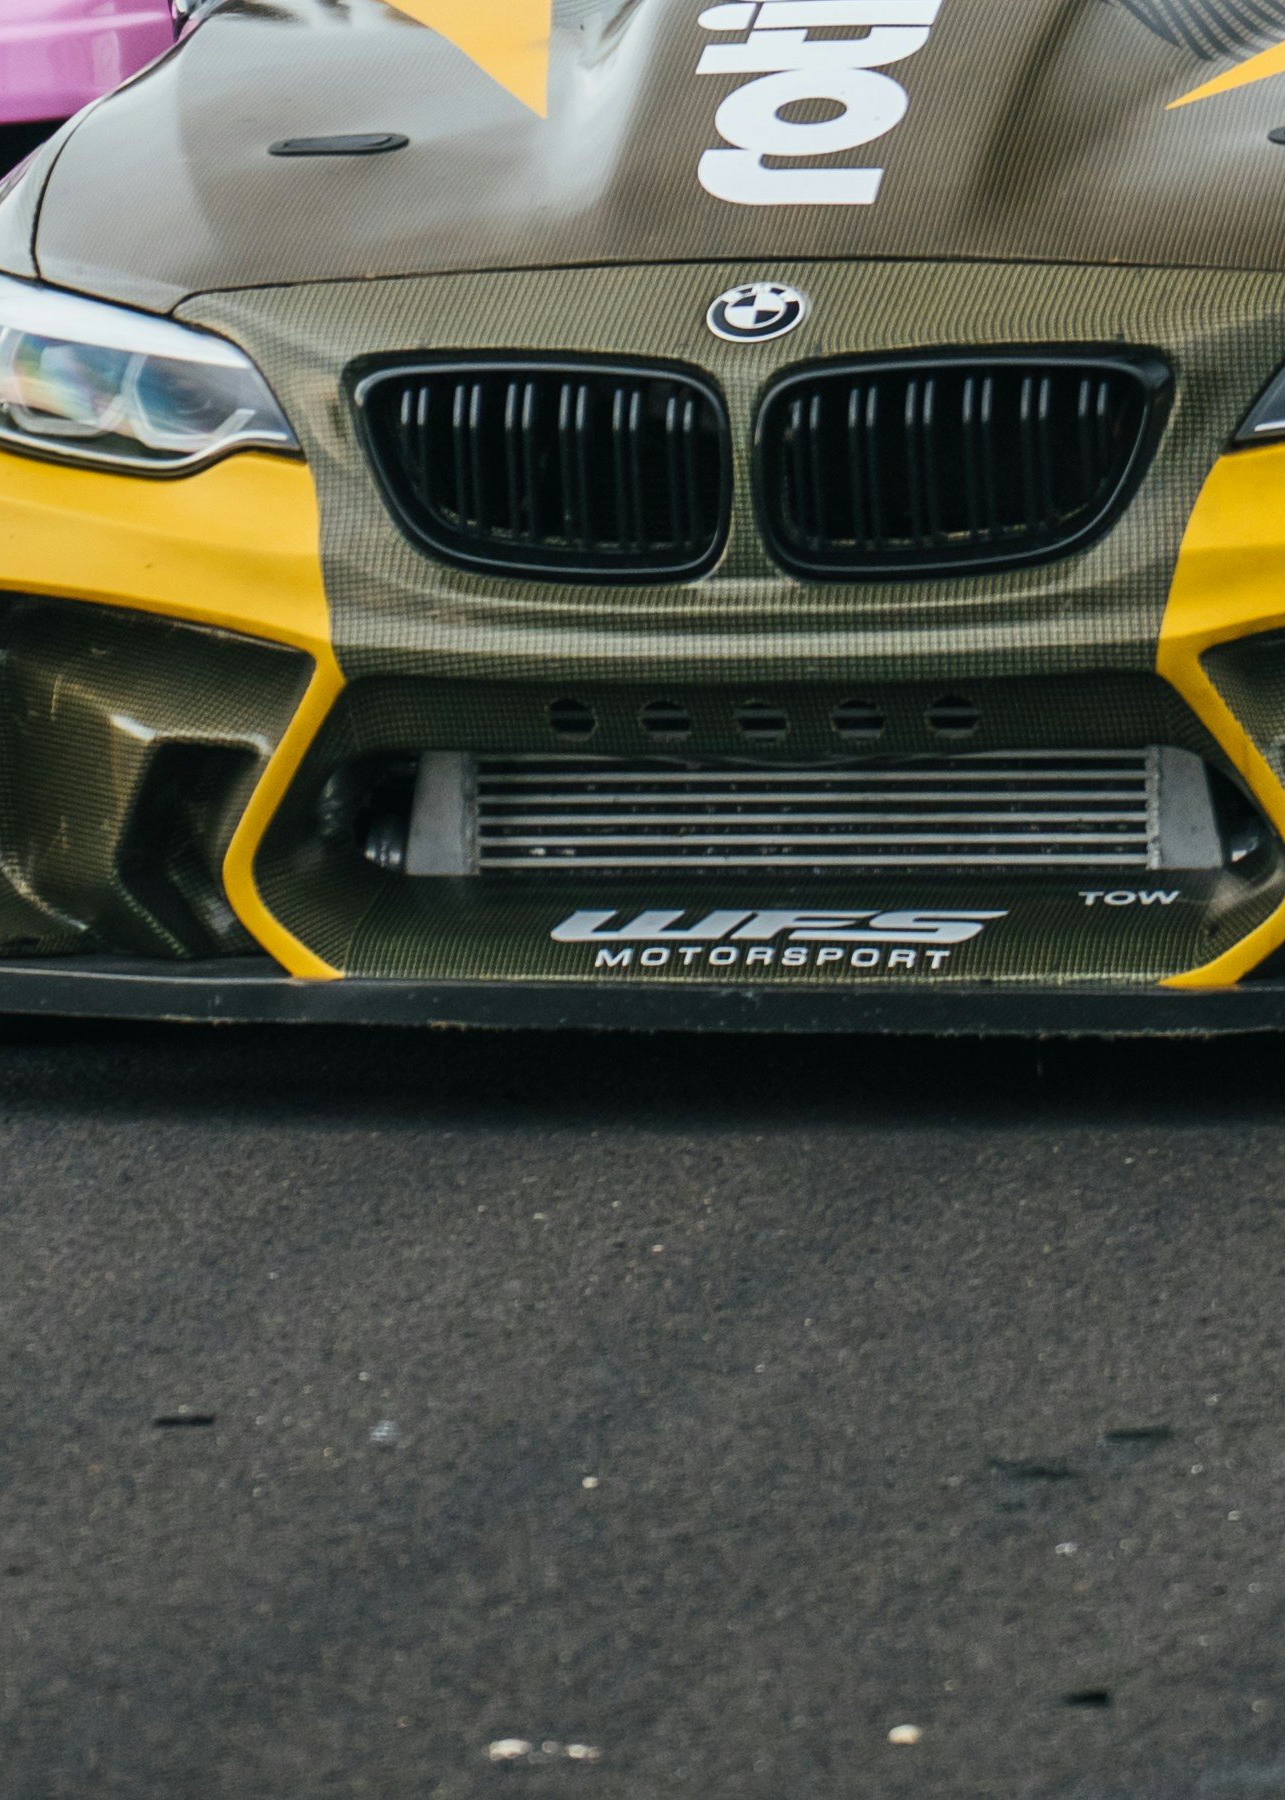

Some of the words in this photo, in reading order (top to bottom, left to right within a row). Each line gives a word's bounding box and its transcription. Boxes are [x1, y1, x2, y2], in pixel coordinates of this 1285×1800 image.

[1078, 890, 1182, 907] TOW
[550, 909, 1011, 944] WFS
[593, 946, 952, 970] MOTORSPORT
